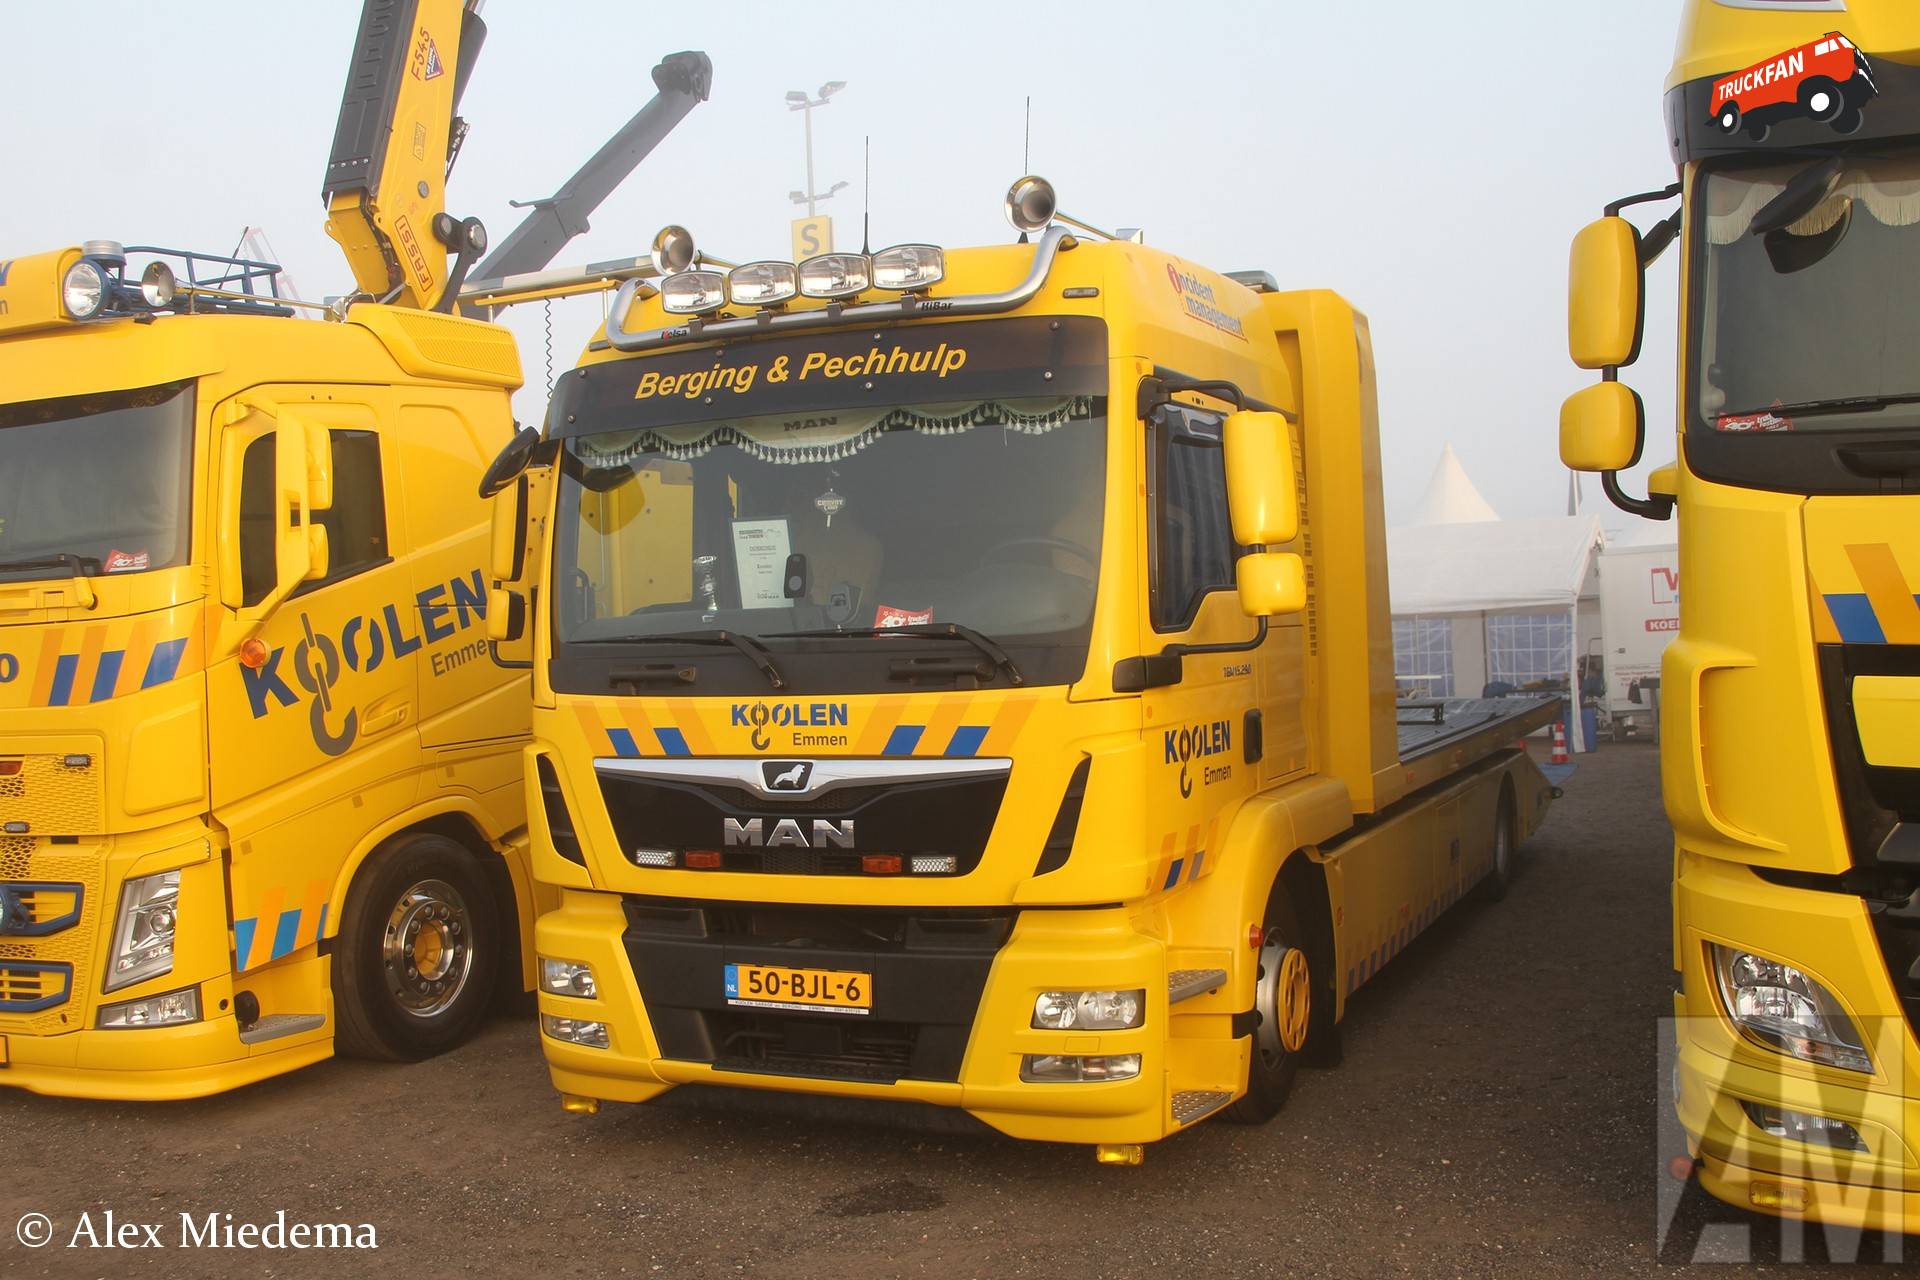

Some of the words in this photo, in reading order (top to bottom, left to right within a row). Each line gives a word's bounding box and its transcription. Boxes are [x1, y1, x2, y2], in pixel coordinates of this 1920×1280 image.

[411, 26, 430, 81] F545
[399, 222, 429, 285] FASSI
[801, 223, 820, 256] S
[921, 301, 953, 311] HiBar
[634, 363, 757, 399] Berging
[766, 355, 790, 383] &
[799, 343, 967, 381] Pechhulp
[783, 416, 838, 432] MAN
[1650, 620, 1680, 631] KOE
[239, 568, 490, 720] KOOLEN
[431, 639, 489, 677] Emme
[731, 703, 848, 727] KOOLEN
[793, 733, 848, 746] Emmen
[1164, 720, 1231, 765] KOOLEN
[1204, 765, 1232, 786] Emmen
[724, 817, 855, 849] MAN
[727, 983, 737, 993] NL
[749, 970, 861, 1002] 50-BJL-6
